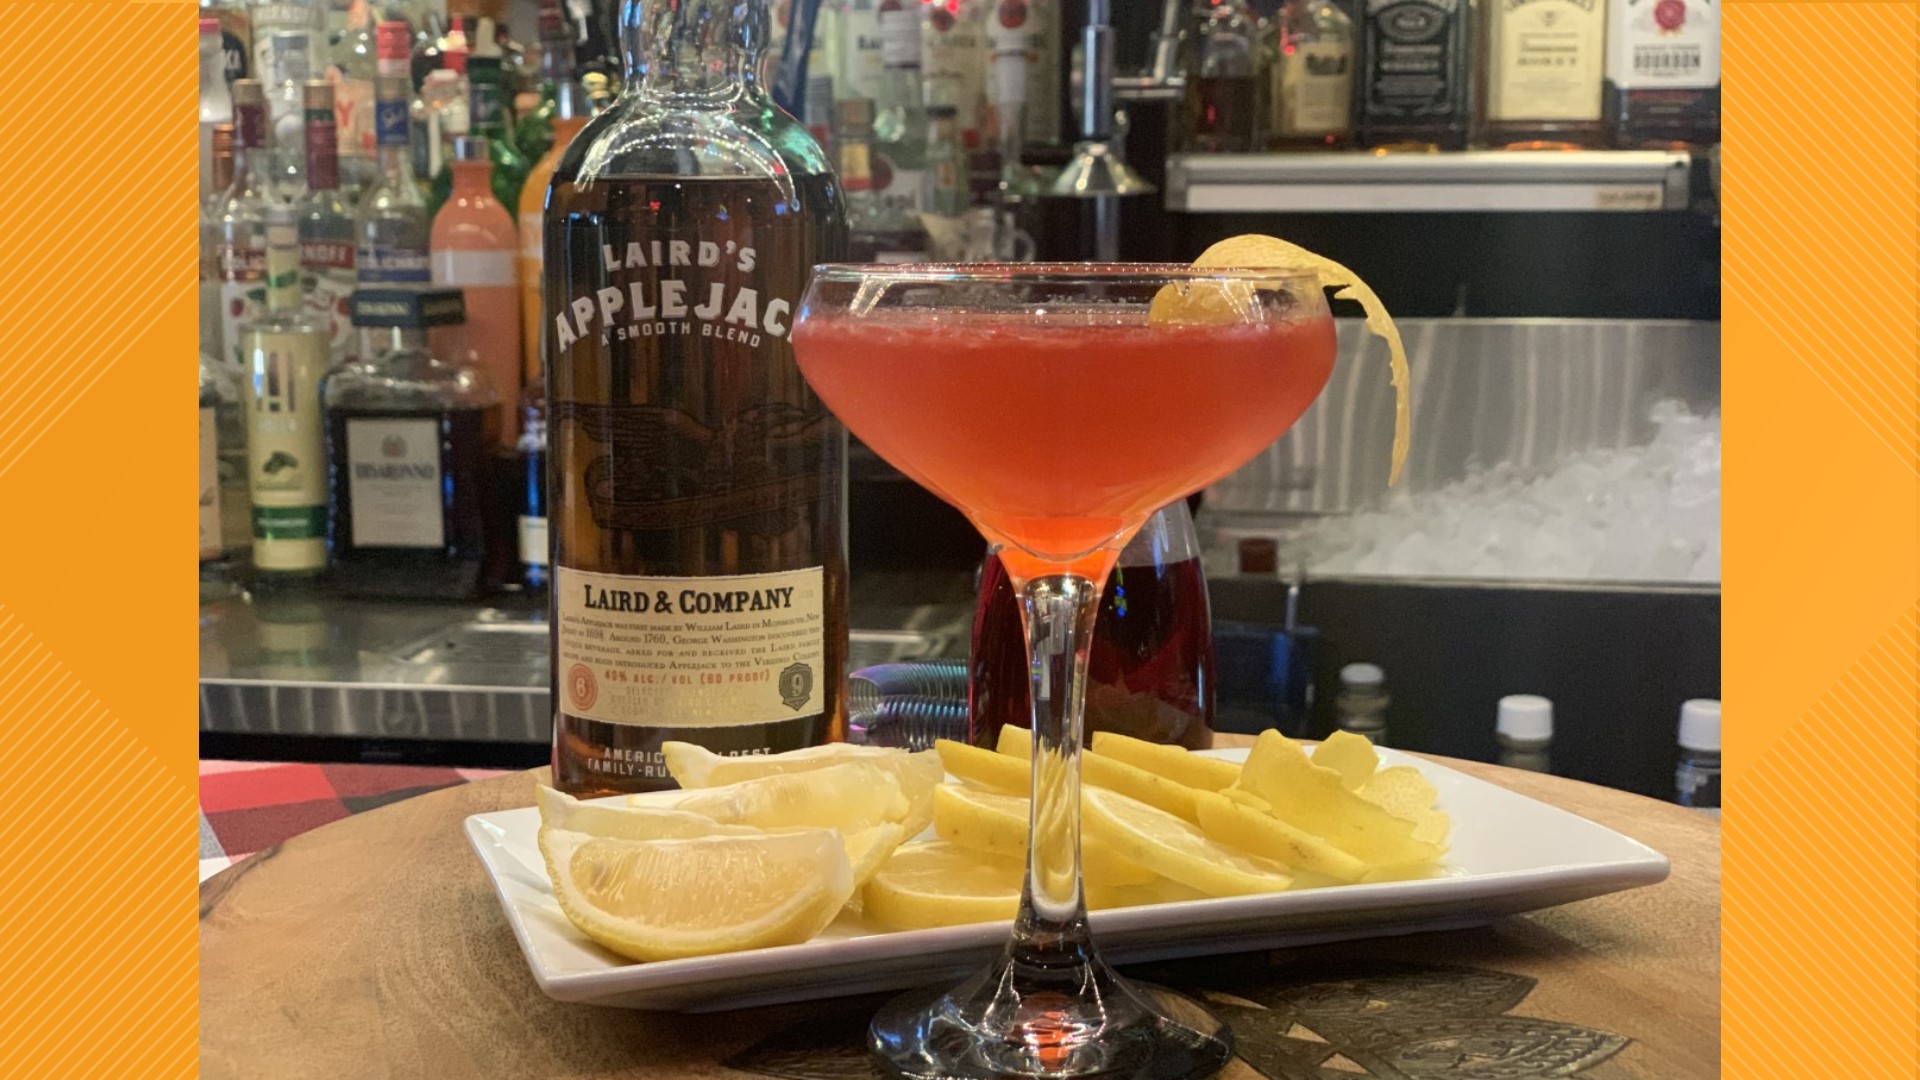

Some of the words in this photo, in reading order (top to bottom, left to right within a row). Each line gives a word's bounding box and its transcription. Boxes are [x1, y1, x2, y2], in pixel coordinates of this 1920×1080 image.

[603, 240, 757, 272] LAIRD'S
[555, 280, 793, 354] APPLEJAC
[617, 322, 691, 341] SMOOTH
[702, 323, 761, 348] BLEND
[584, 584, 650, 613] LAIRD
[654, 590, 673, 614] &
[679, 586, 794, 614] COMPANY
[672, 635, 709, 644] GEORGE
[711, 634, 766, 644] WASHINGTON
[702, 648, 746, 657] RECEIVED
[576, 677, 586, 697] 8
[791, 673, 804, 697] 9
[604, 747, 664, 764] AMERIC
[588, 758, 673, 778] FAMILY-RU
